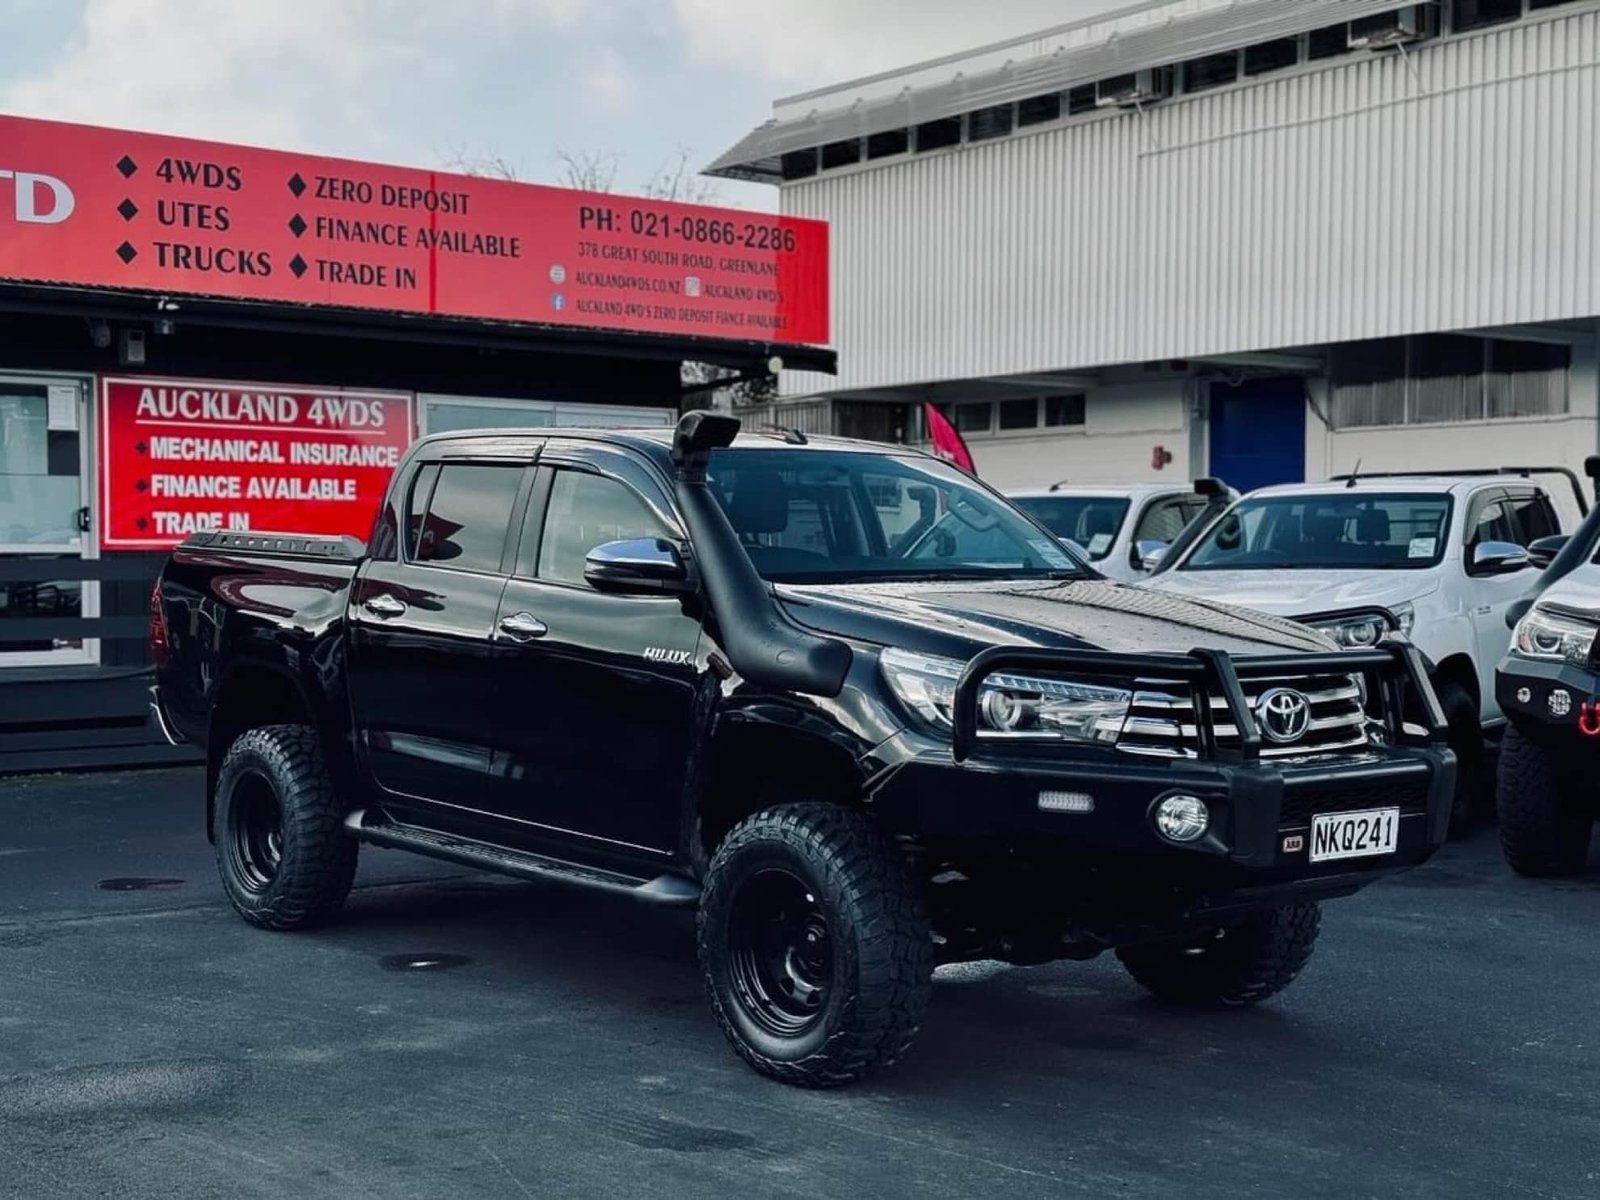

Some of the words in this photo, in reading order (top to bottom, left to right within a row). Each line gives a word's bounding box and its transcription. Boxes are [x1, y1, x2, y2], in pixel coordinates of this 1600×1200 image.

[155, 158, 242, 192] 4WDS
[314, 176, 373, 204] ZERO
[381, 183, 470, 216] DEPOSIT
[156, 200, 230, 232] UTES
[579, 206, 621, 232] PH:
[630, 209, 796, 252] 021-0866-2286
[315, 216, 408, 247] FINANCE
[416, 227, 521, 258] AVAILABLE
[152, 241, 272, 277] TRUCKS
[315, 259, 388, 288] TRADE
[395, 266, 417, 290] IN
[578, 241, 599, 259] 378
[602, 244, 639, 262] GREAT
[642, 248, 679, 267] SOUTH
[719, 258, 782, 276] GREENLANE
[136, 387, 299, 423] AUCKLAND
[306, 398, 385, 427] 4WDS
[150, 436, 284, 464] MECHANICAL
[289, 442, 399, 467] INSURANCE
[151, 475, 241, 498] FINANCE
[246, 477, 357, 500] AVAILABLE
[152, 511, 223, 534] TRADE
[229, 512, 250, 532] IN
[643, 647, 691, 666] HILUX
[1314, 816, 1393, 855] NKQ241
